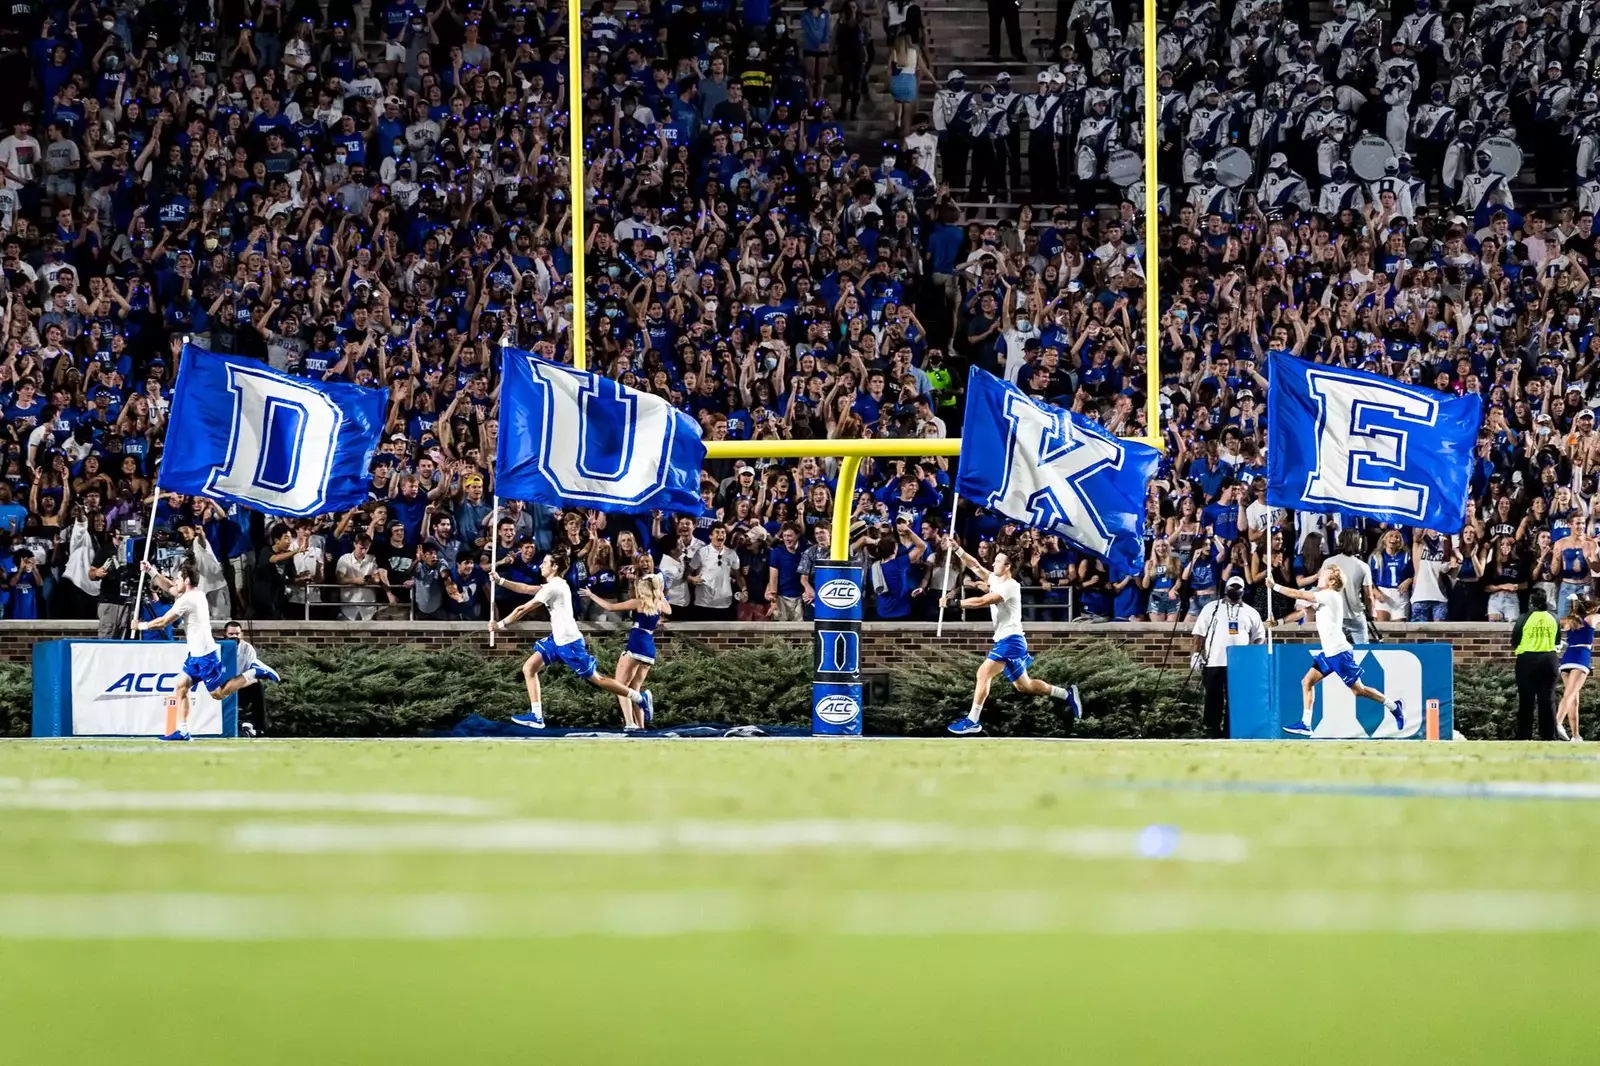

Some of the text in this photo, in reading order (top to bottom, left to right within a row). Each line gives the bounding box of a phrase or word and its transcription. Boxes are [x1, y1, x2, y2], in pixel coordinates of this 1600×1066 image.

[195, 52, 216, 62] DUKE
[657, 129, 677, 138] UKE
[160, 204, 185, 212] DUKE
[305, 358, 328, 371] DUKE
[526, 357, 676, 506] U
[203, 362, 343, 516] D
[1301, 368, 1439, 520] E
[126, 444, 142, 453] DUKE
[987, 390, 1125, 557] K
[1490, 524, 1515, 536] DUKE
[1390, 567, 1397, 586] 1
[827, 587, 856, 597] ACC
[817, 630, 860, 674] D
[821, 702, 854, 713] ACC
